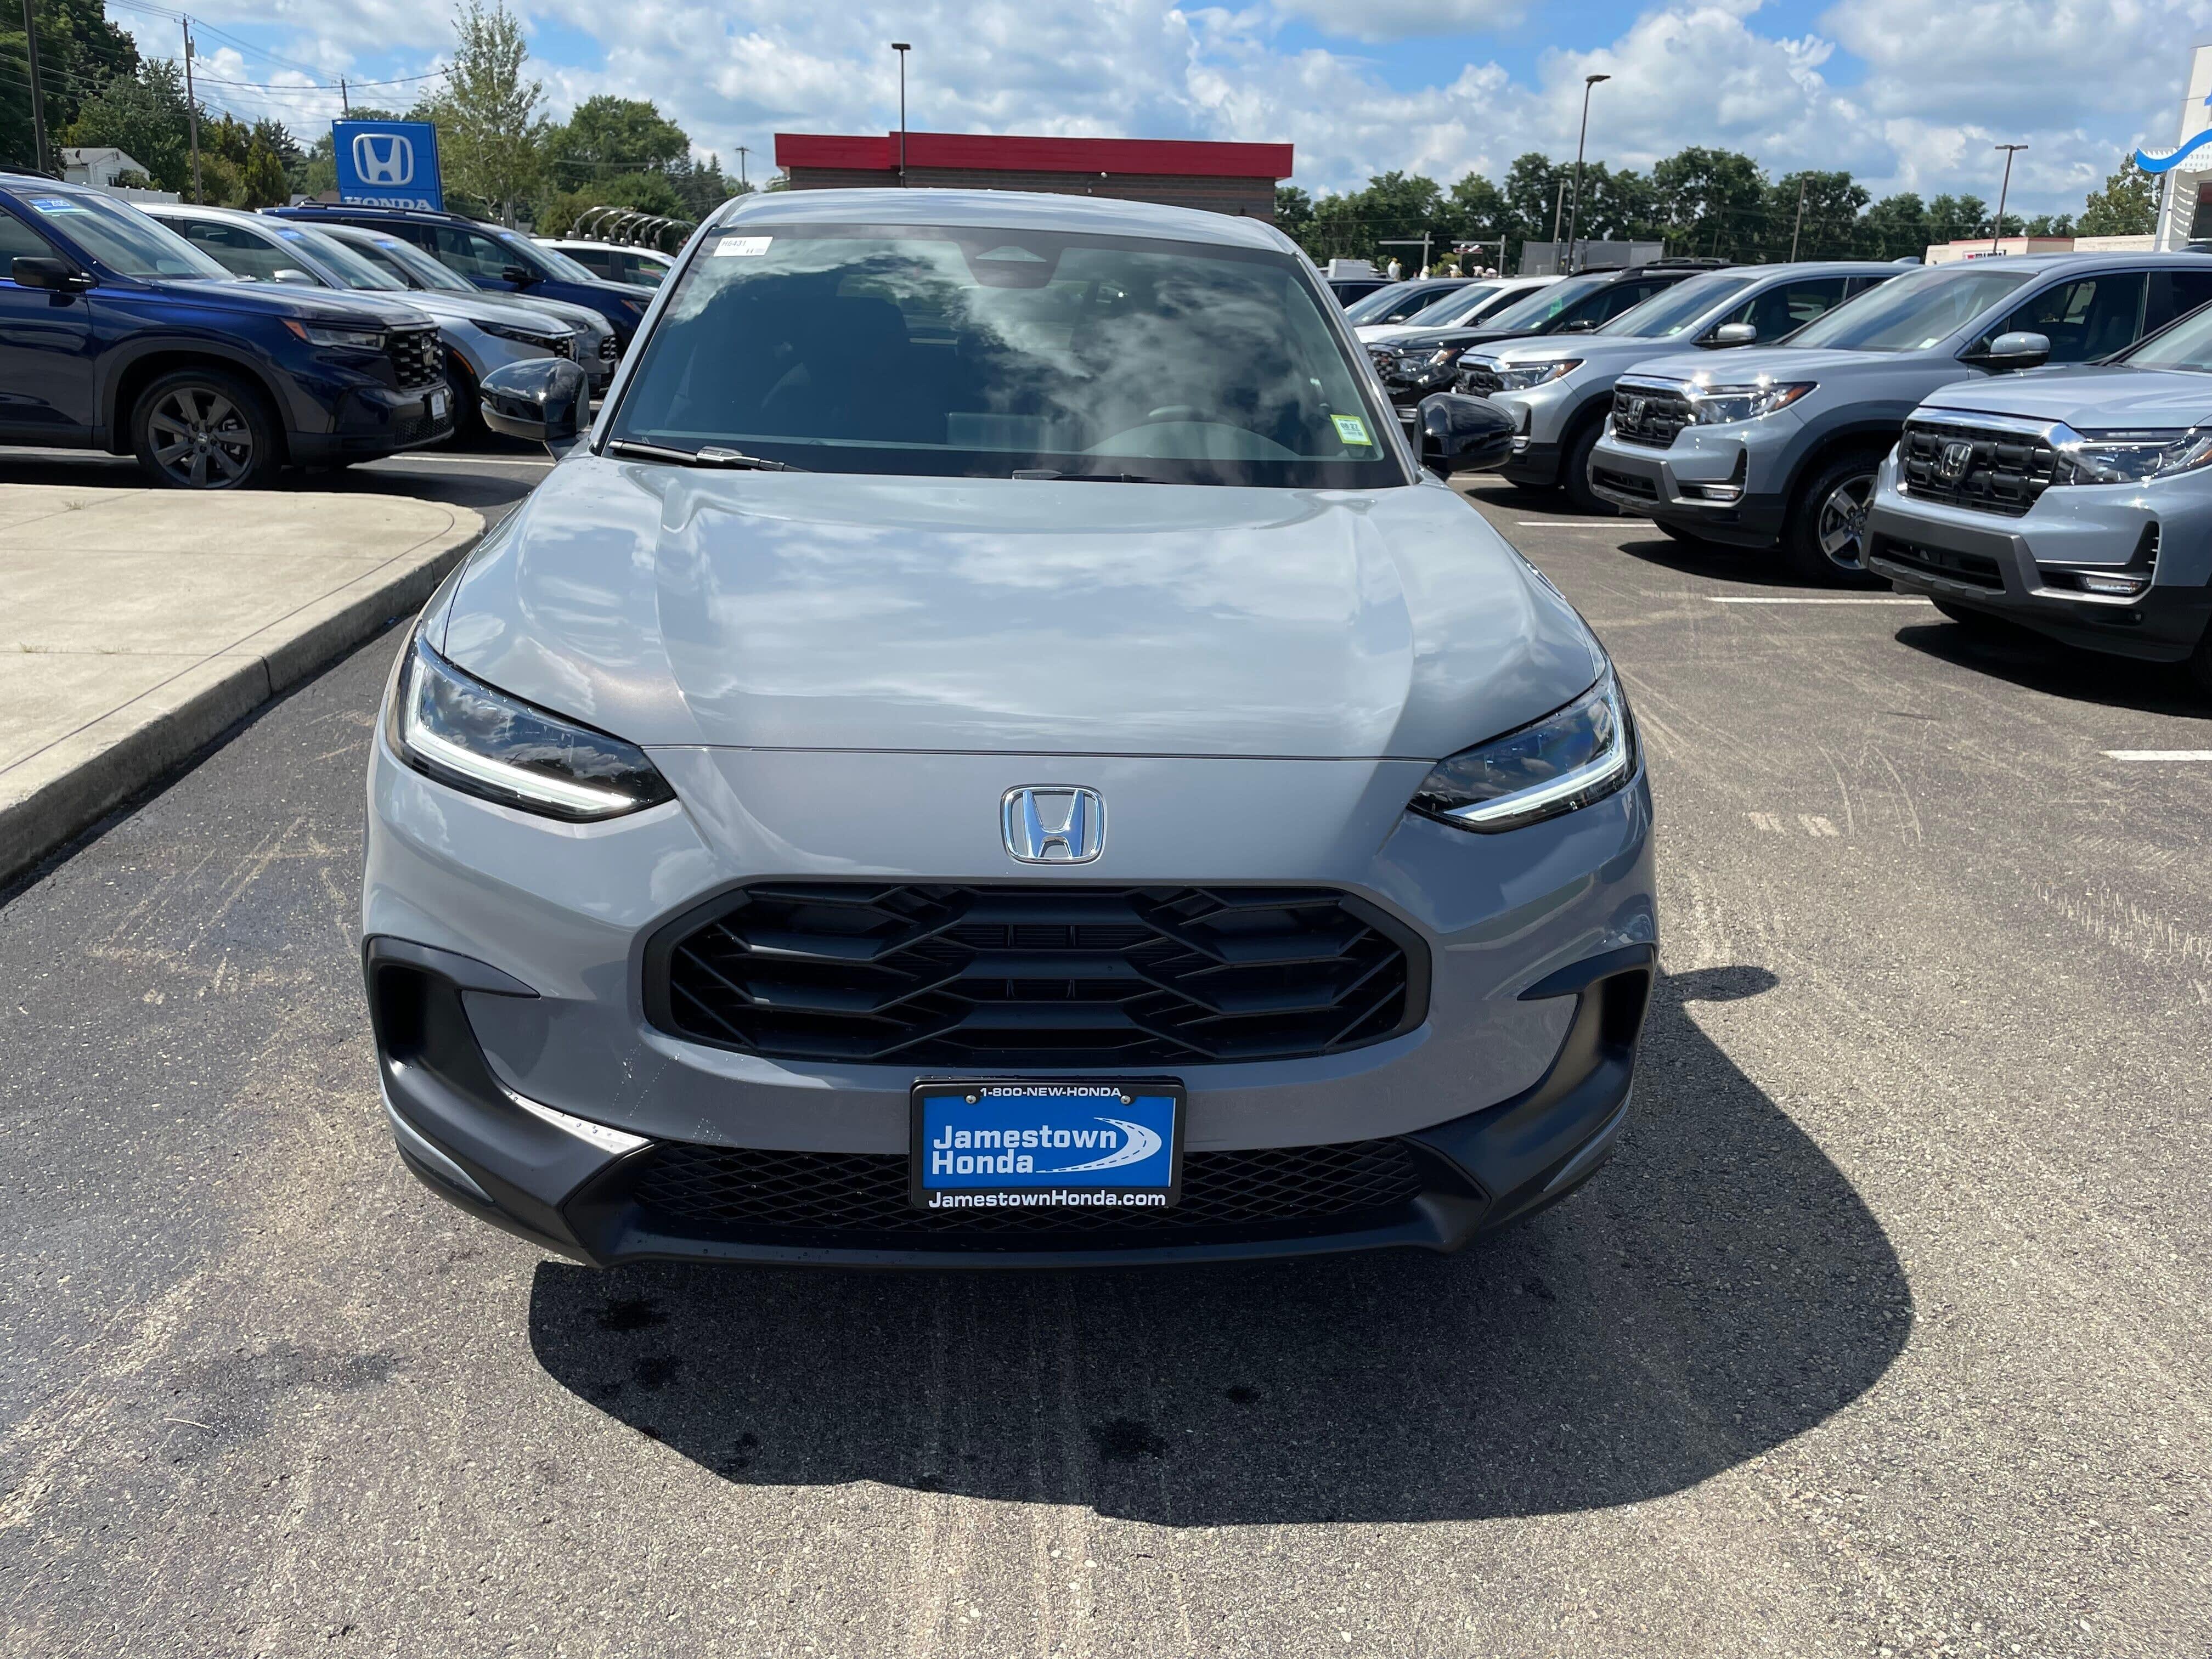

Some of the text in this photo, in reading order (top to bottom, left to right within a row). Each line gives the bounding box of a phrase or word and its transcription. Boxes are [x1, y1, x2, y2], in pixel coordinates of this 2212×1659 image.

[344, 196, 435, 212] HONDA
[979, 1087, 1122, 1097] 1-800-NEW-HONDA
[933, 1125, 1117, 1149] Jamestown
[933, 1149, 1034, 1175] Honda
[928, 1189, 1166, 1208] JamestownHonda.com
